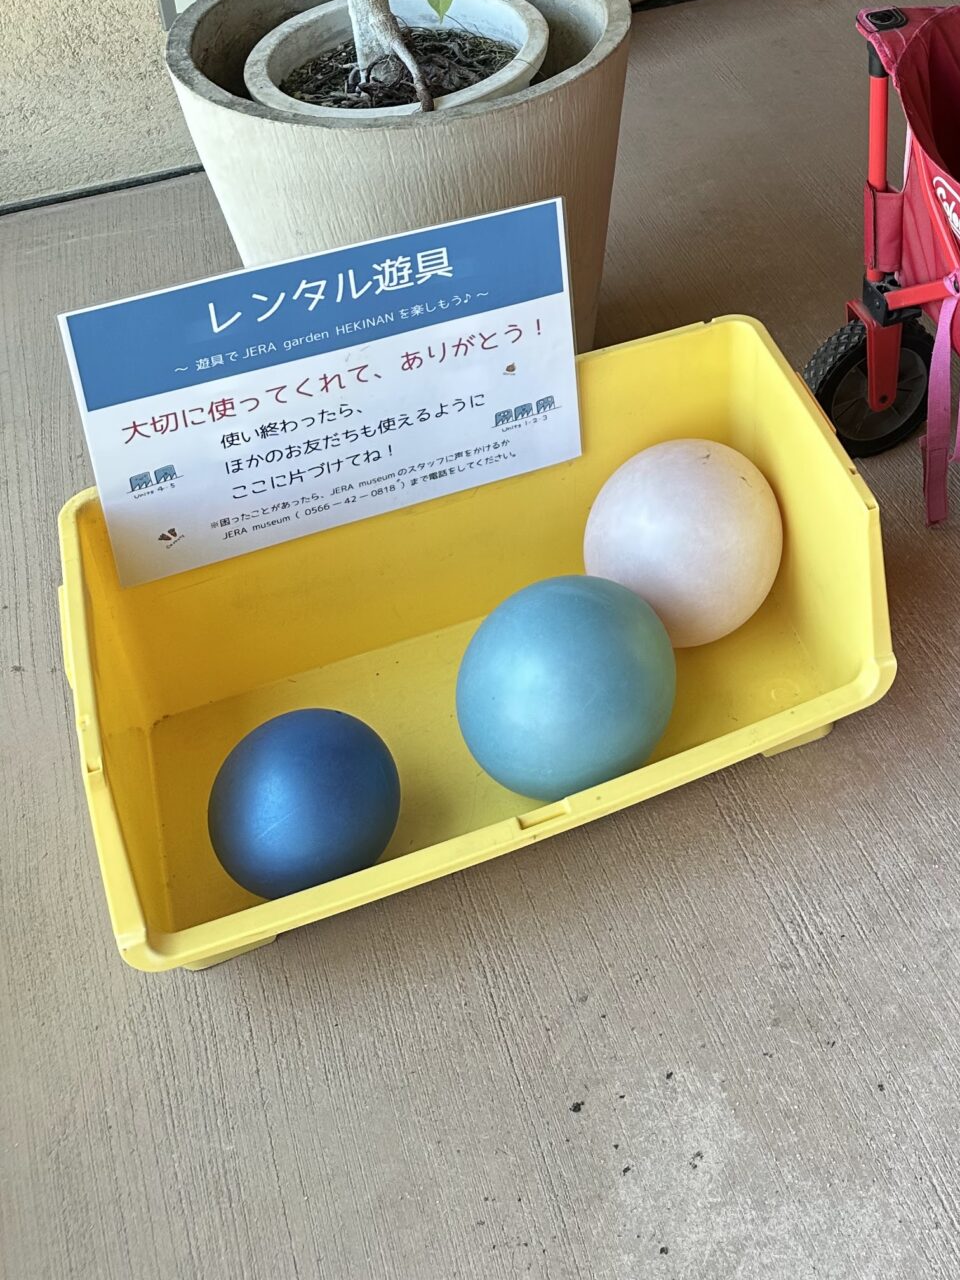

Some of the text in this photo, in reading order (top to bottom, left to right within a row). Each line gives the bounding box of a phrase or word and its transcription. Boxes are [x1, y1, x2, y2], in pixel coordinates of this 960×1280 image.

[207, 246, 454, 334] レンタル遊具
[242, 342, 277, 360] JERA
[283, 330, 329, 352] garden
[335, 311, 395, 336] HEKINAN
[220, 403, 363, 450] 使い終わったら、
[225, 393, 486, 475] ほかのお友だちも使えるように
[232, 444, 393, 500] ここに片づけてね！
[330, 483, 355, 497] JERA
[358, 472, 396, 489] museum
[222, 527, 248, 541] JERA
[252, 515, 291, 532] museum
